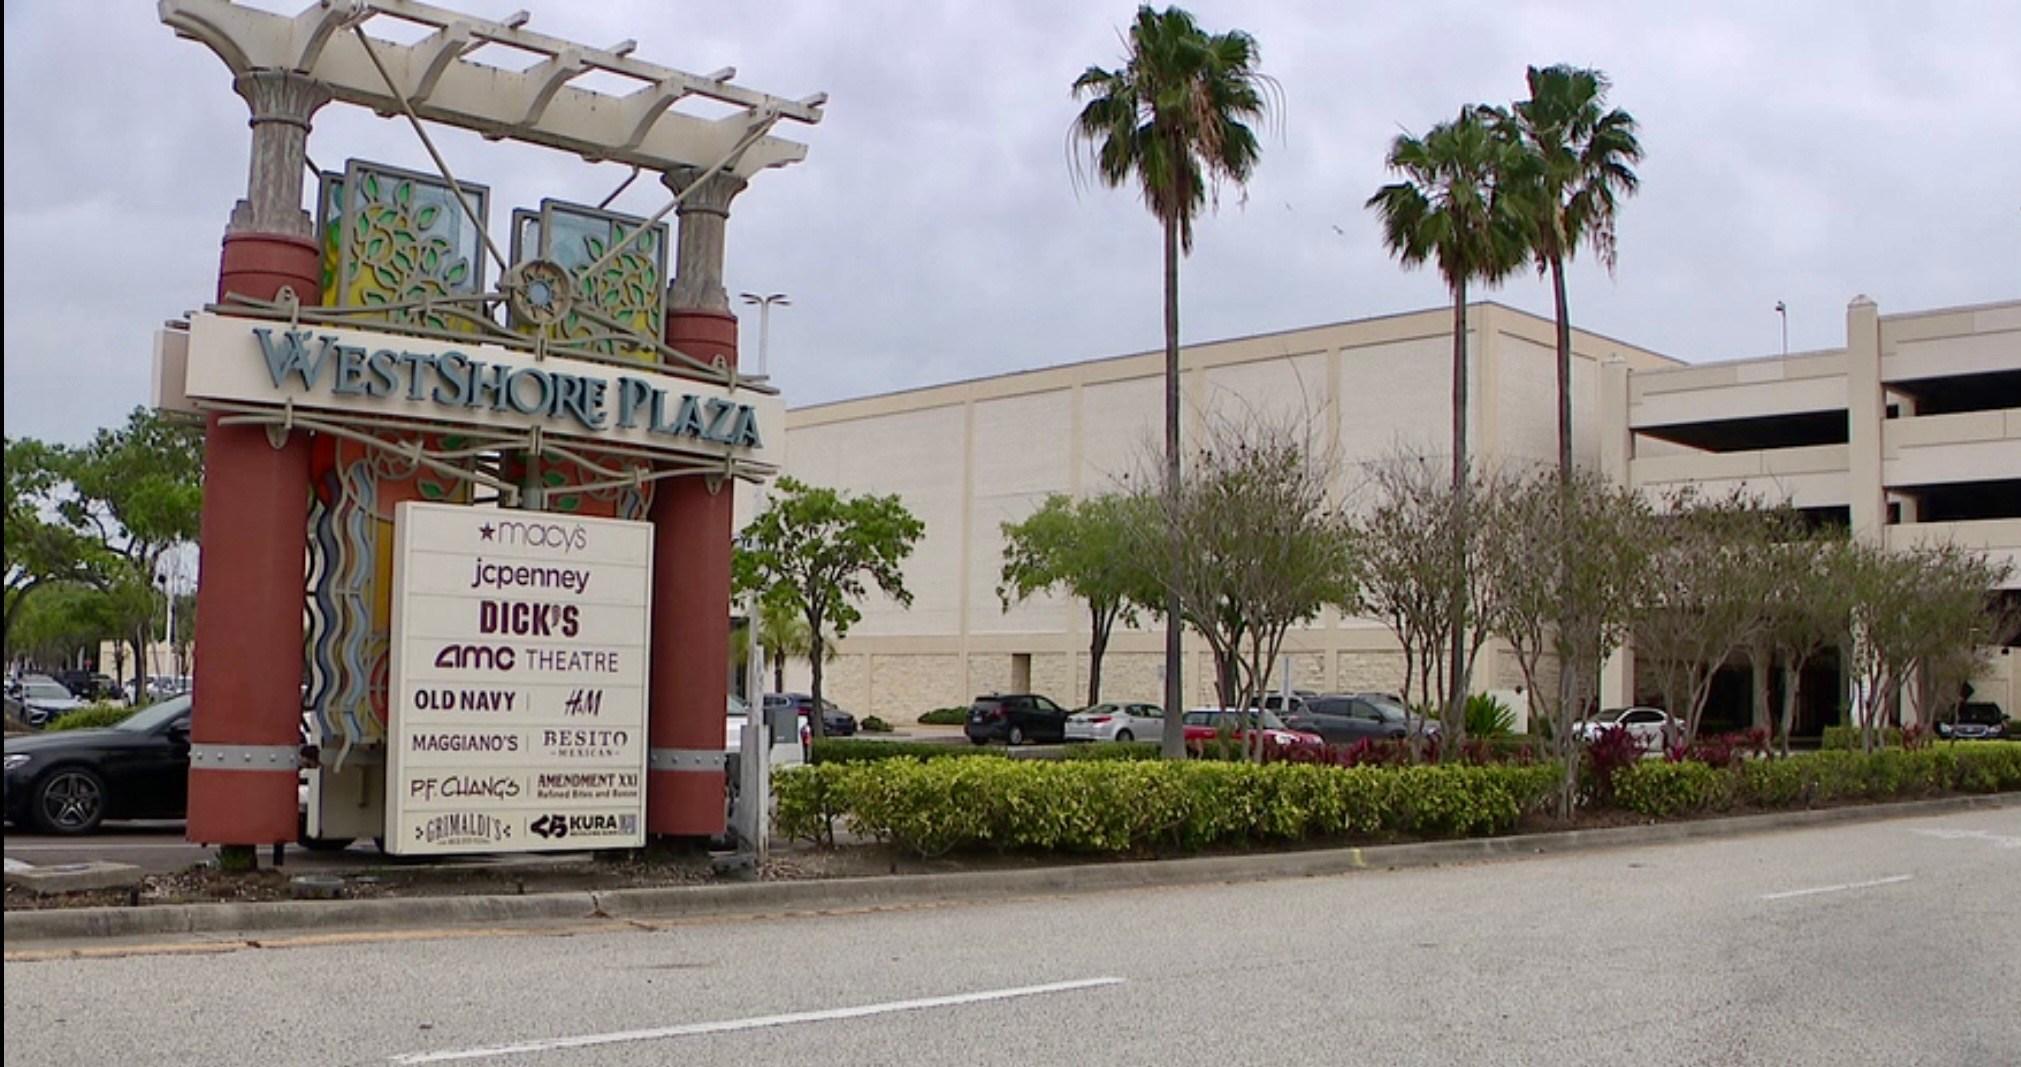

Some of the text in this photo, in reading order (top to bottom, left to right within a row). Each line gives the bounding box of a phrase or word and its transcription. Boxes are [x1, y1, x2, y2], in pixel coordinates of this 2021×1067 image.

[616, 376, 763, 449] PLAZA
[498, 521, 588, 553] macy's
[471, 557, 590, 594] jcpenney
[479, 600, 579, 637] DICK'S
[526, 649, 619, 673] THEATRE
[414, 690, 516, 711] OLD NAVY
[565, 688, 603, 716] H&M
[412, 734, 518, 752] MAGGIANO'S
[543, 730, 629, 747] BESITO
[538, 773, 638, 788] AMENDMENT XXI
[426, 813, 502, 843] GRIMALDI'S
[569, 815, 617, 830] KURA
